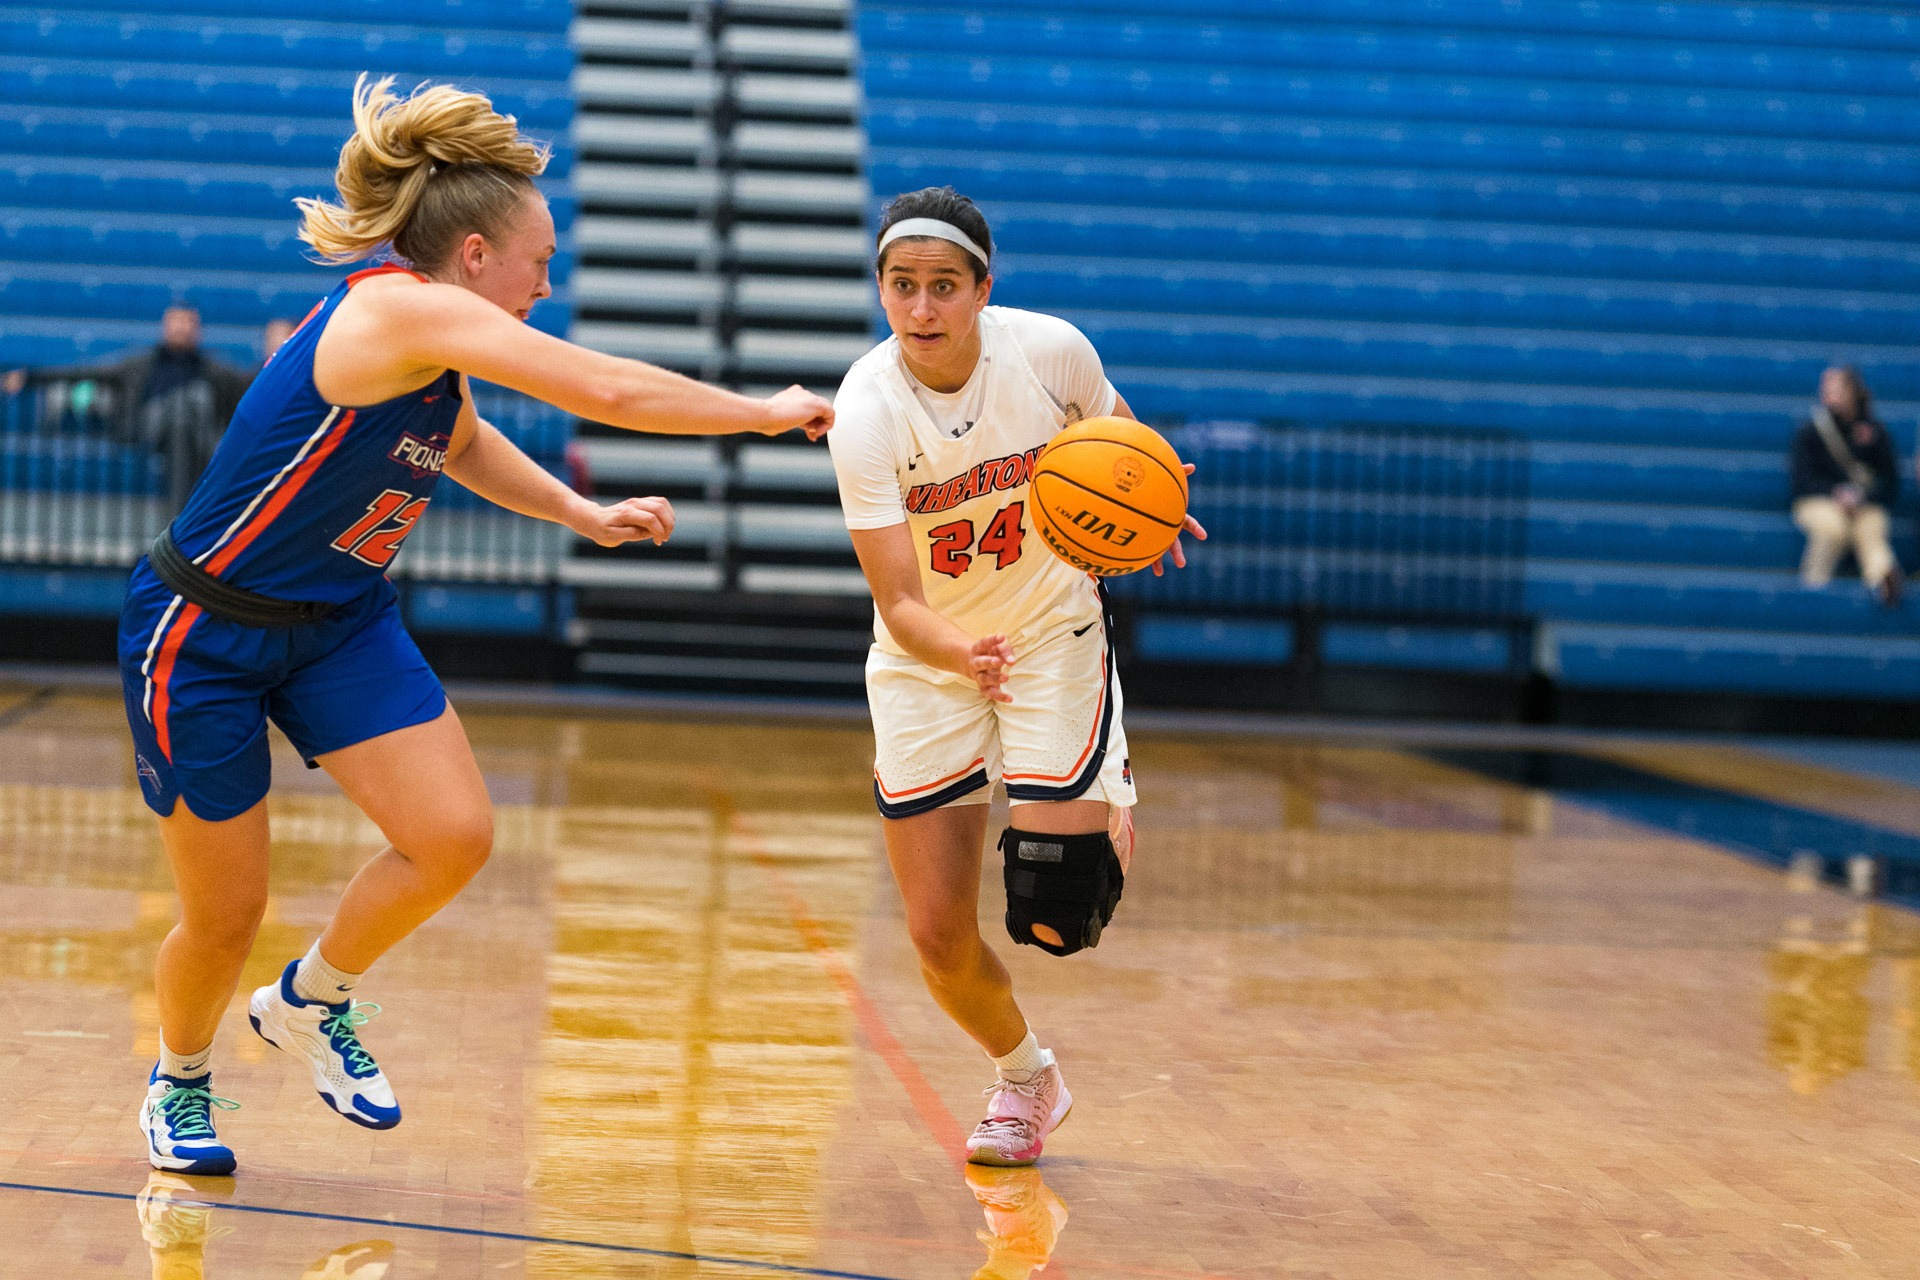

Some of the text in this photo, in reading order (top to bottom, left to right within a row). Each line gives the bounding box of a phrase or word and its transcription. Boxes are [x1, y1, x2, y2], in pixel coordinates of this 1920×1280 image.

[330, 489, 431, 568] 12
[928, 500, 1026, 579] 24
[1042, 525, 1135, 576] Wilson
[1054, 505, 1137, 546] EVO NXT
